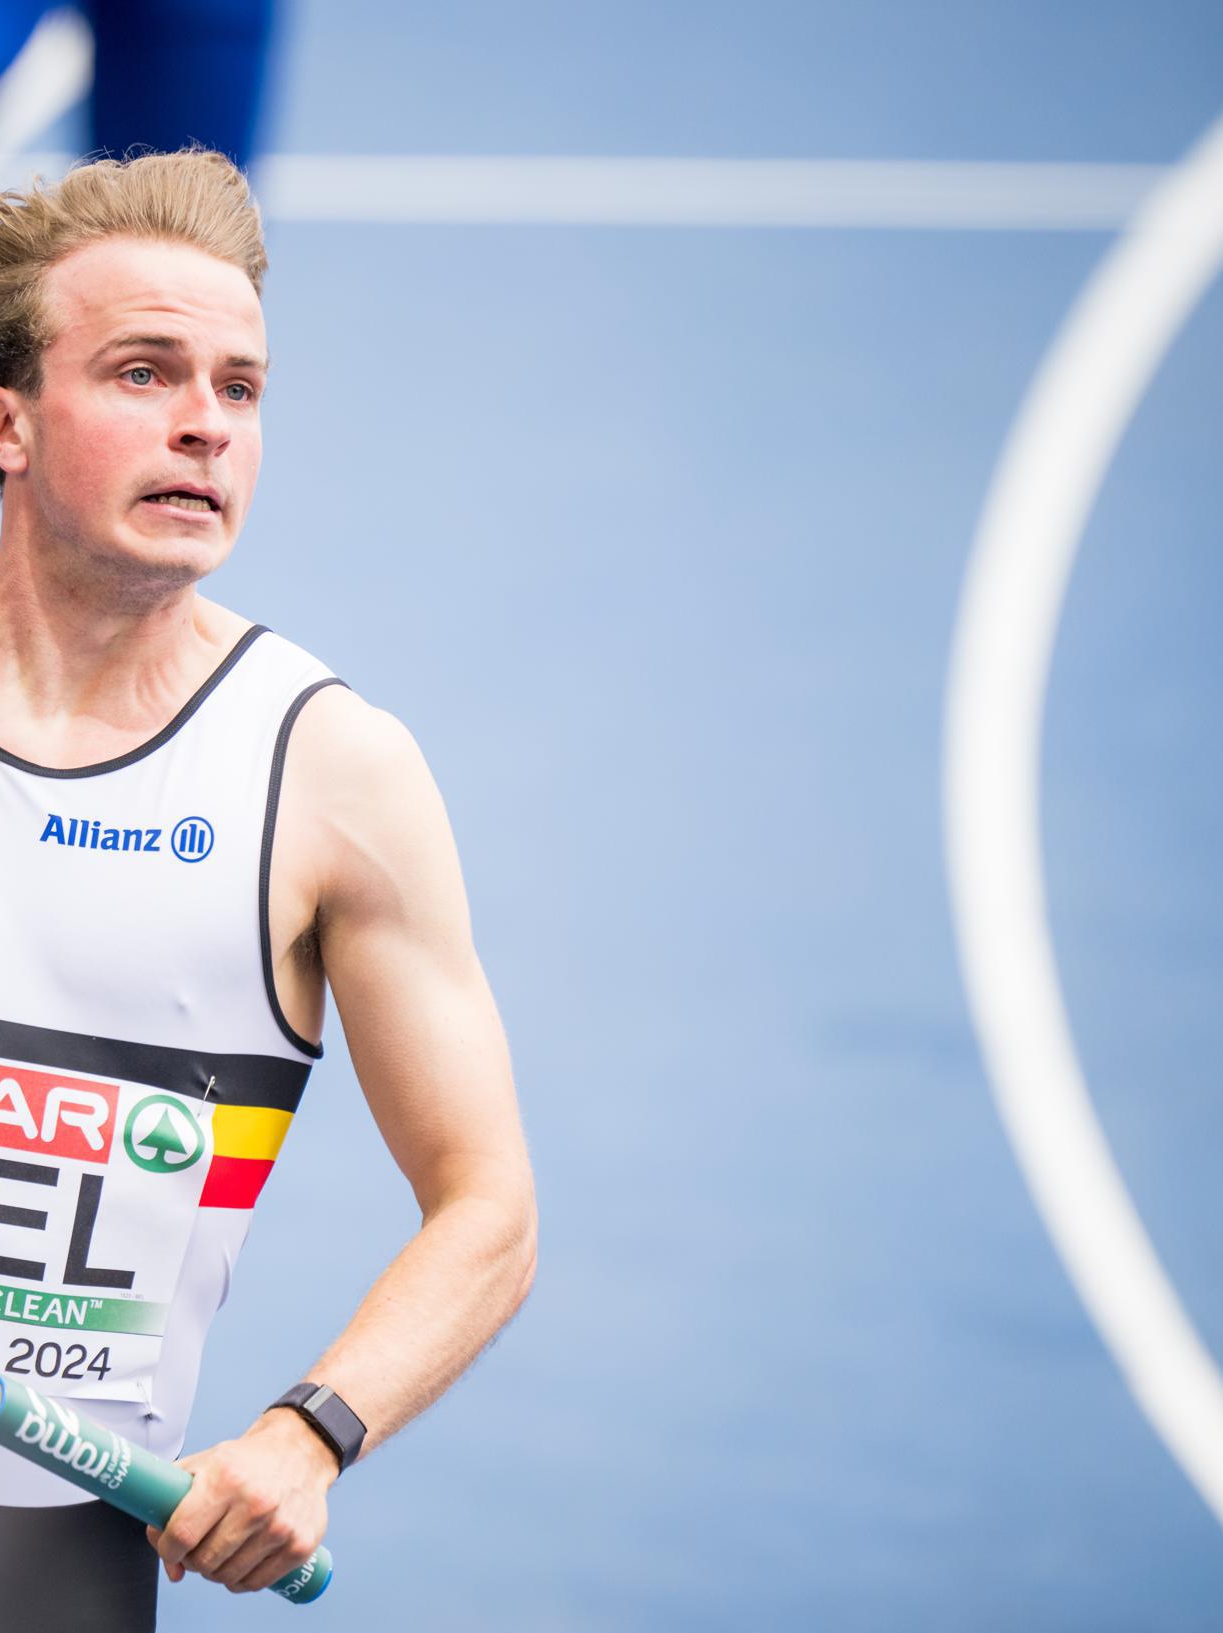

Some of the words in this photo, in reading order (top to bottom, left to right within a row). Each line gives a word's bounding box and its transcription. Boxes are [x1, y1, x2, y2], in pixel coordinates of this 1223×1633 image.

[39, 813, 163, 853] Allianz
[5, 1337, 112, 1381] 2024
[14, 1410, 111, 1478] roma
